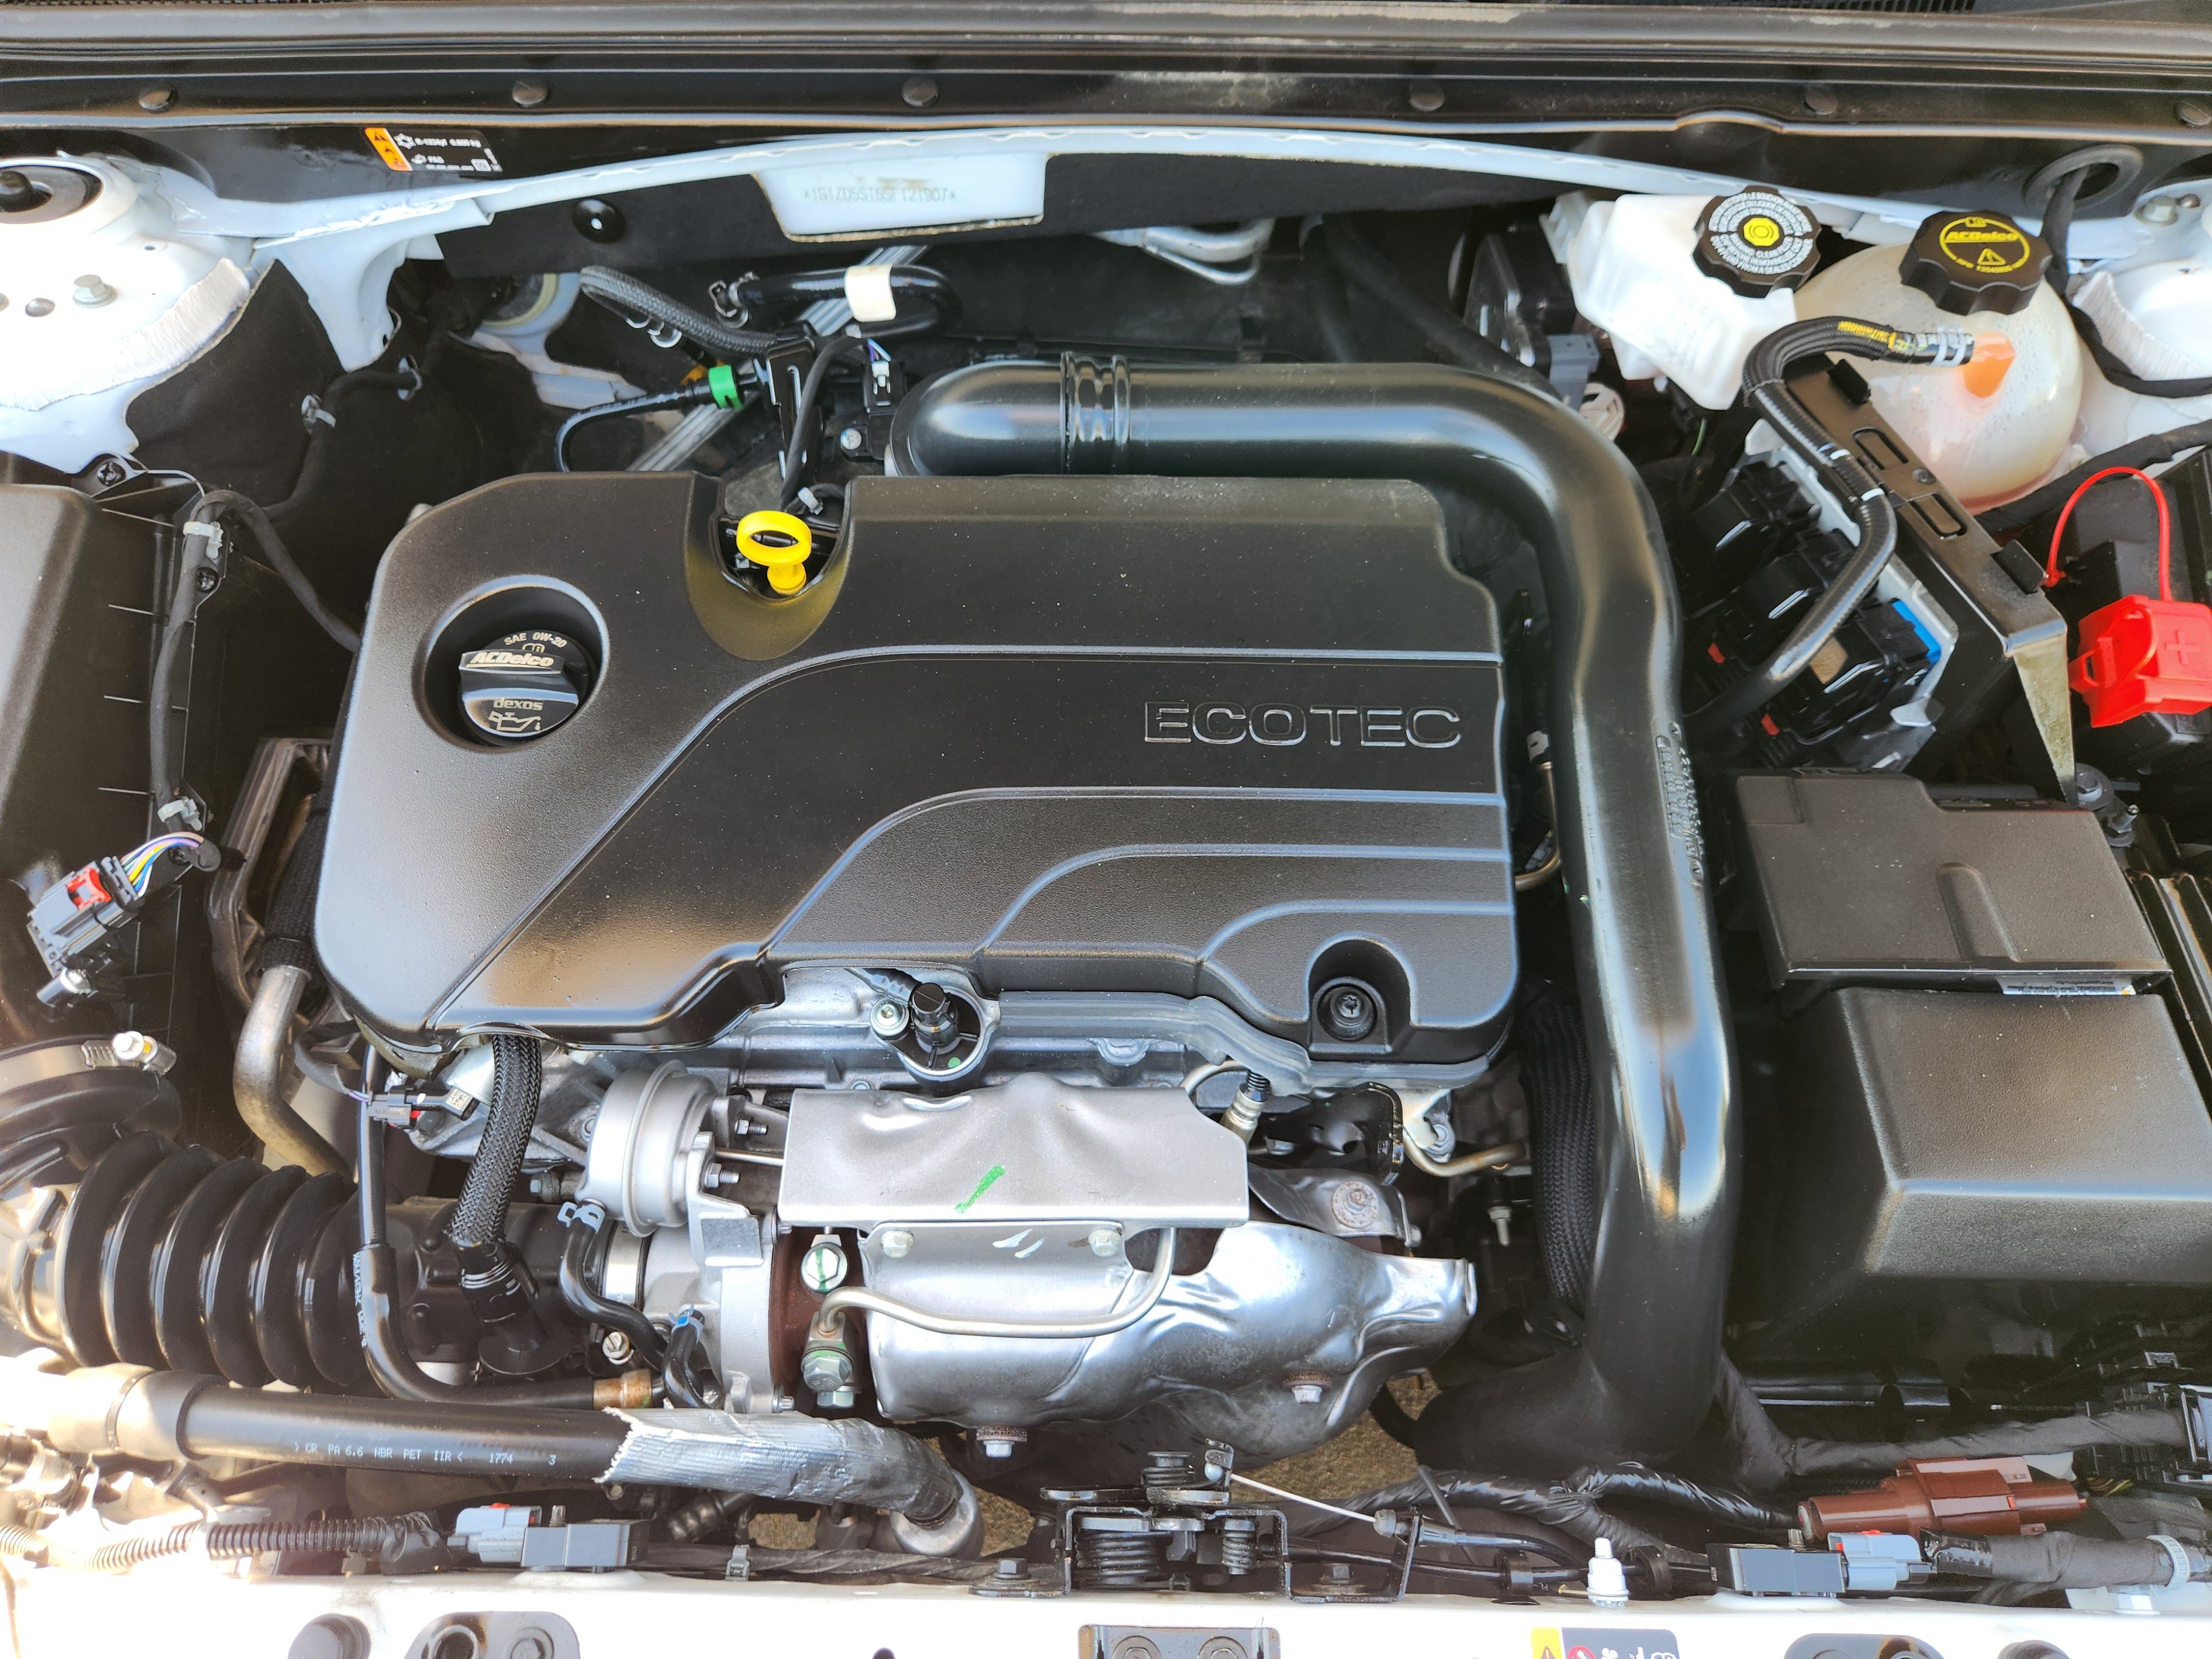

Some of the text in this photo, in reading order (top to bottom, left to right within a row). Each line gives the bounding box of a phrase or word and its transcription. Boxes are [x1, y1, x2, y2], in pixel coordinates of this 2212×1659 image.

[1945, 231, 2019, 241] ACDelco
[504, 632, 568, 648] SAE 0W-20
[470, 652, 555, 667] ACDelco
[493, 698, 544, 711] dexos
[1144, 701, 1461, 749] ECOTEC
[305, 1443, 318, 1454] CR
[328, 1444, 341, 1455] PA
[345, 1445, 364, 1458] 6.6
[374, 1447, 393, 1459] NBR
[403, 1449, 421, 1460] PET
[489, 1453, 514, 1463] 1774
